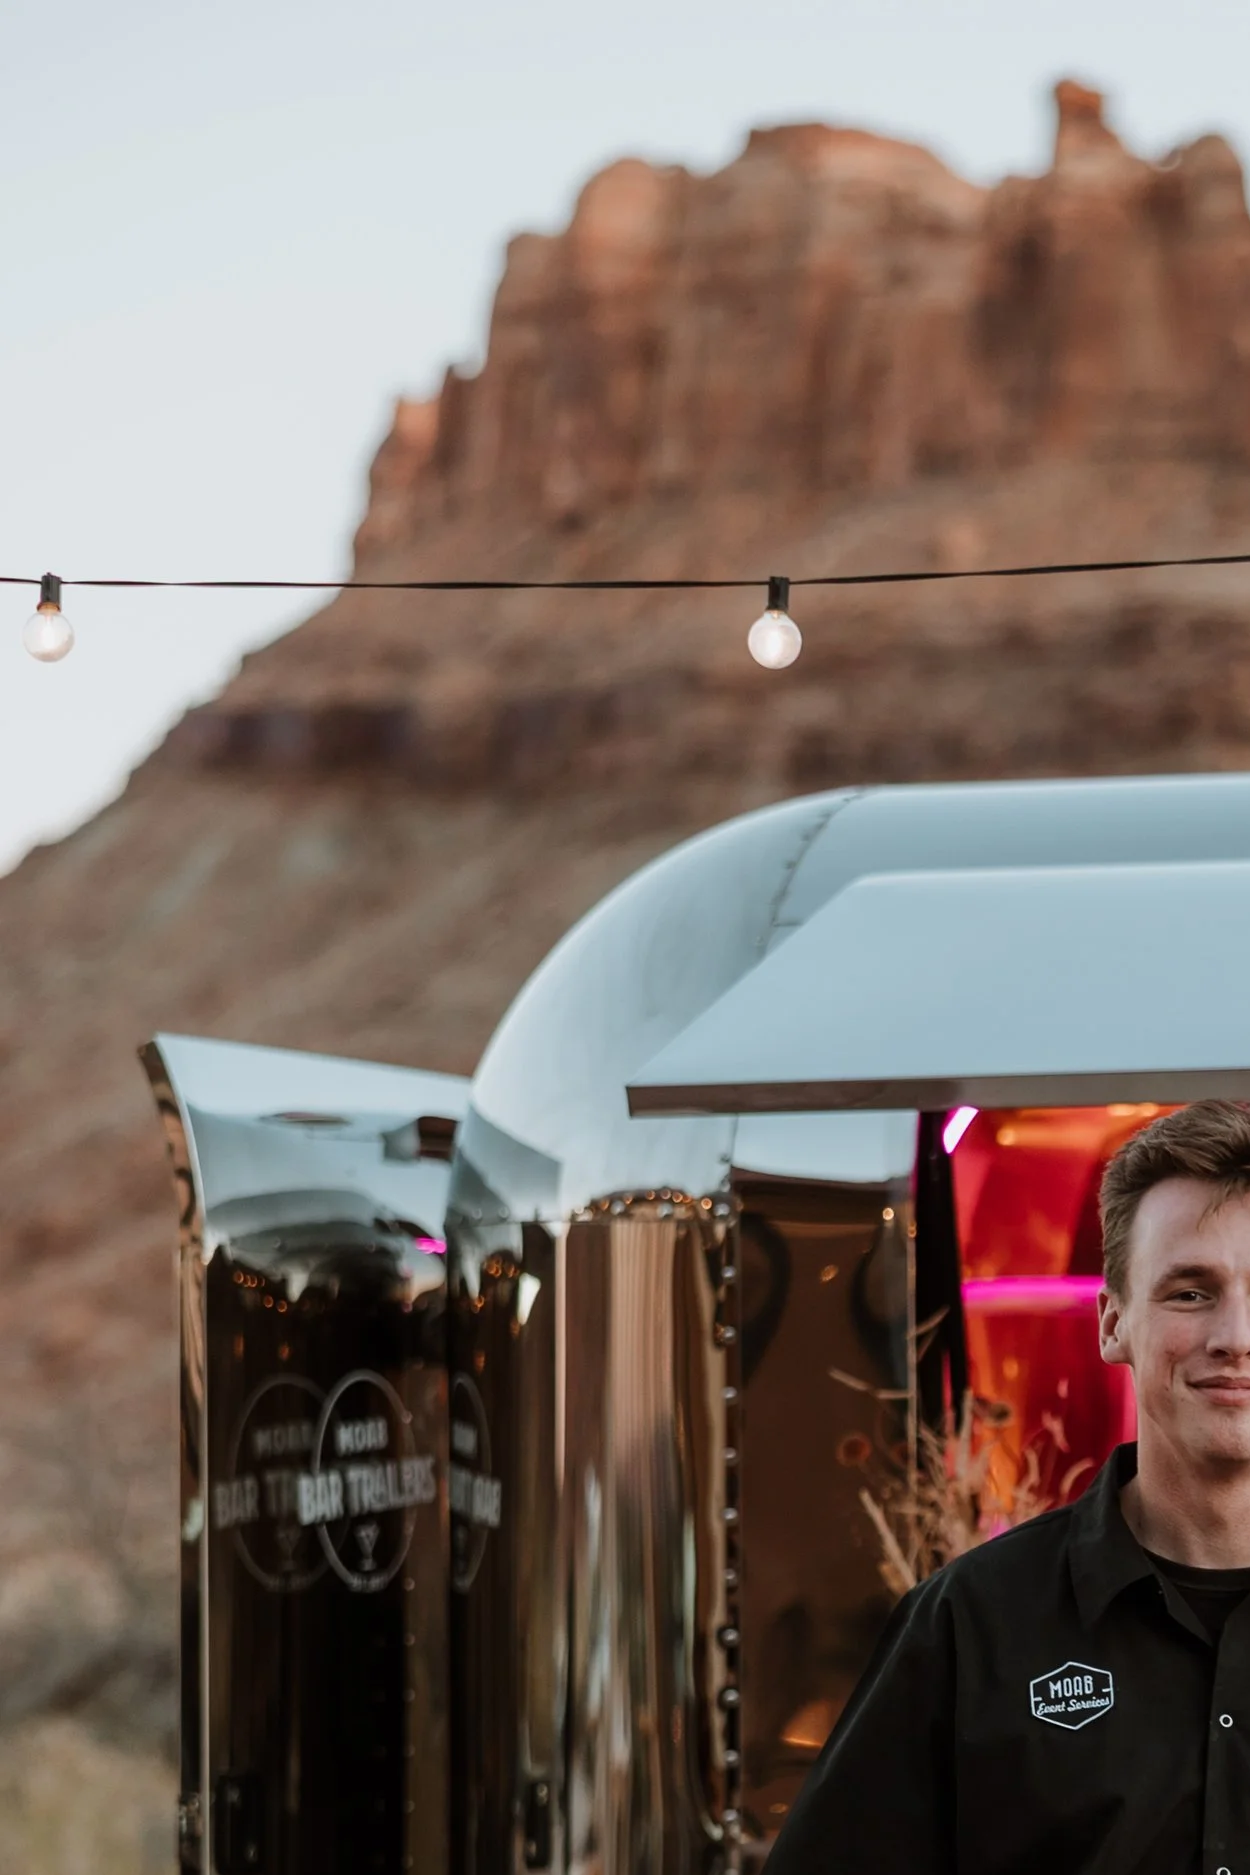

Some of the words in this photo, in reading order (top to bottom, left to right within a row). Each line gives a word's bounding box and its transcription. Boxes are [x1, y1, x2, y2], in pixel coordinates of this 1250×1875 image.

[297, 1468, 345, 1526] BAR
[1048, 1675, 1094, 1699] MOAB
[1036, 1701, 1066, 1716] Event
[1067, 1697, 1110, 1712] Services
